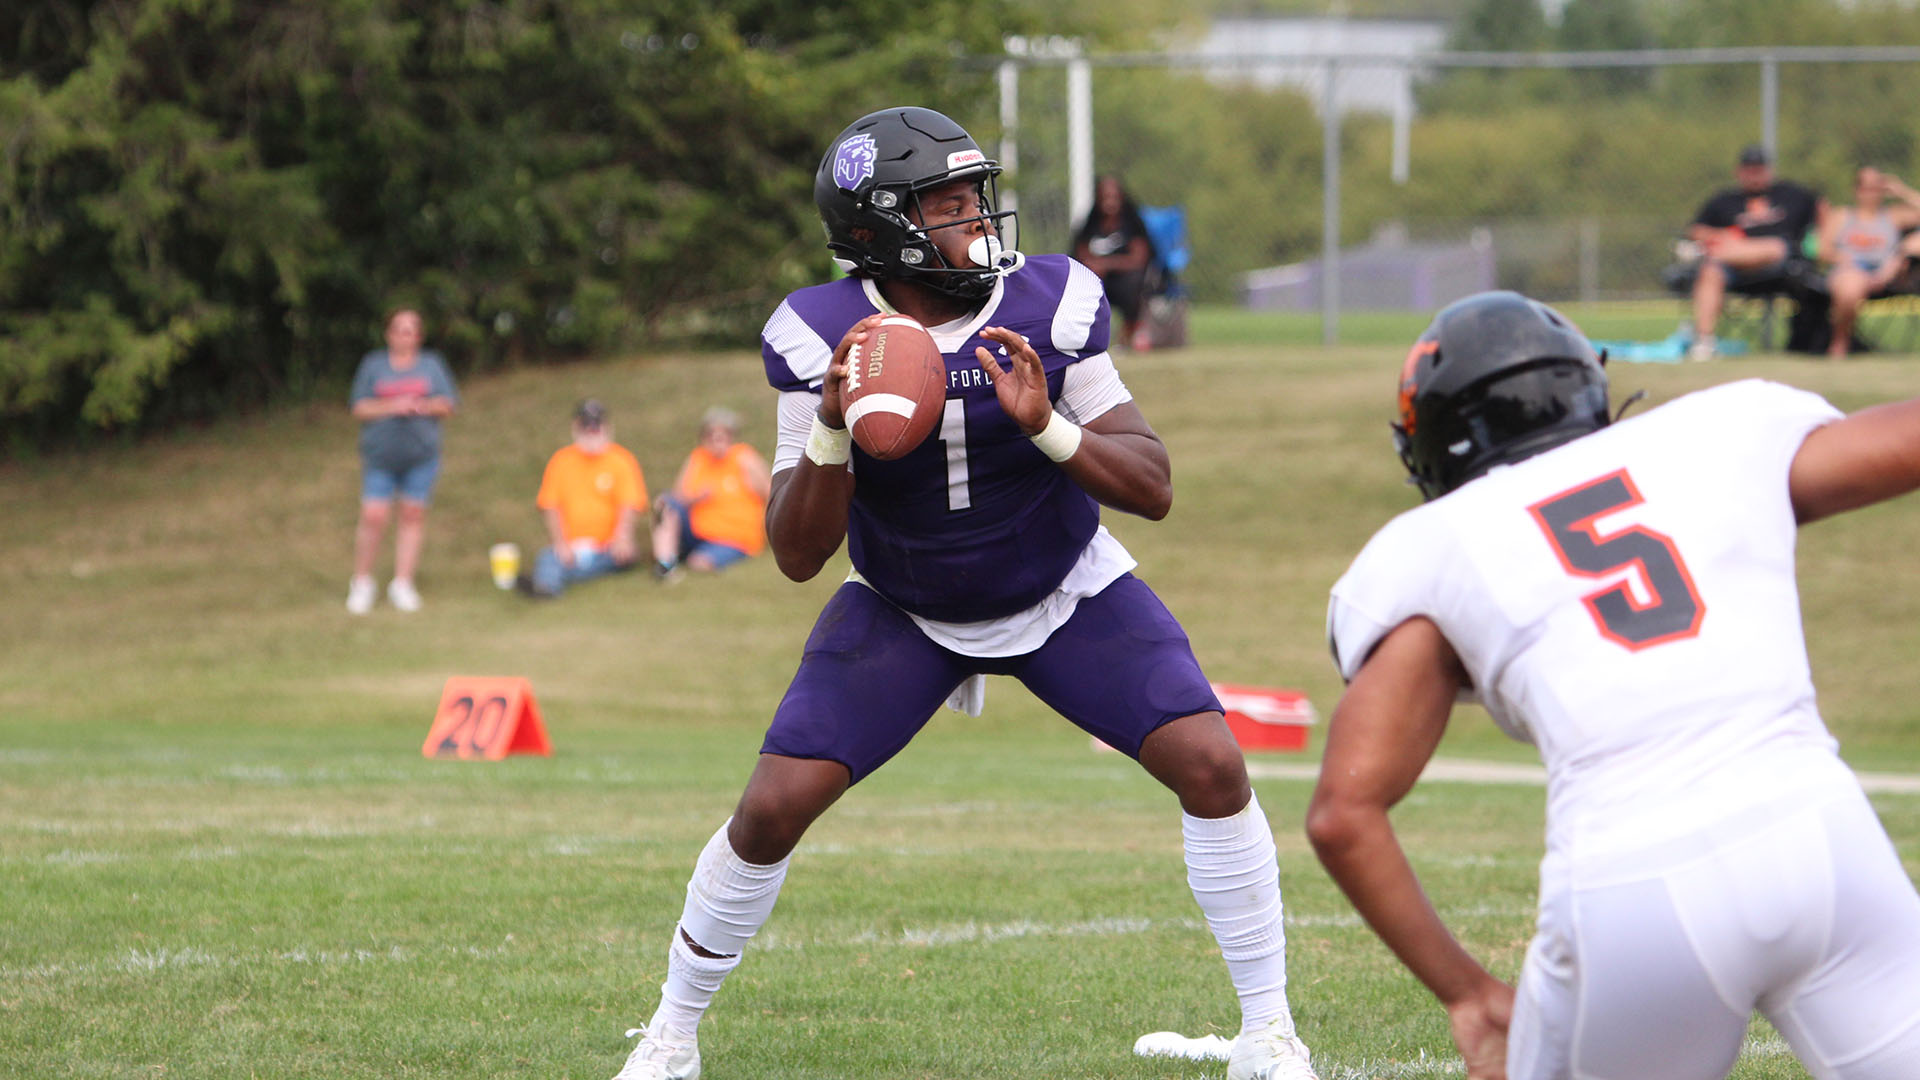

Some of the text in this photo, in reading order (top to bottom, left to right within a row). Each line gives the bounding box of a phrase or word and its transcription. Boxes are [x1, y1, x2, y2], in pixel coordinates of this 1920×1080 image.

[837, 158, 859, 181] RU
[868, 332, 888, 378] Wilson
[938, 398, 971, 510] 1
[1525, 467, 1707, 653] 5
[437, 696, 507, 756] 20
